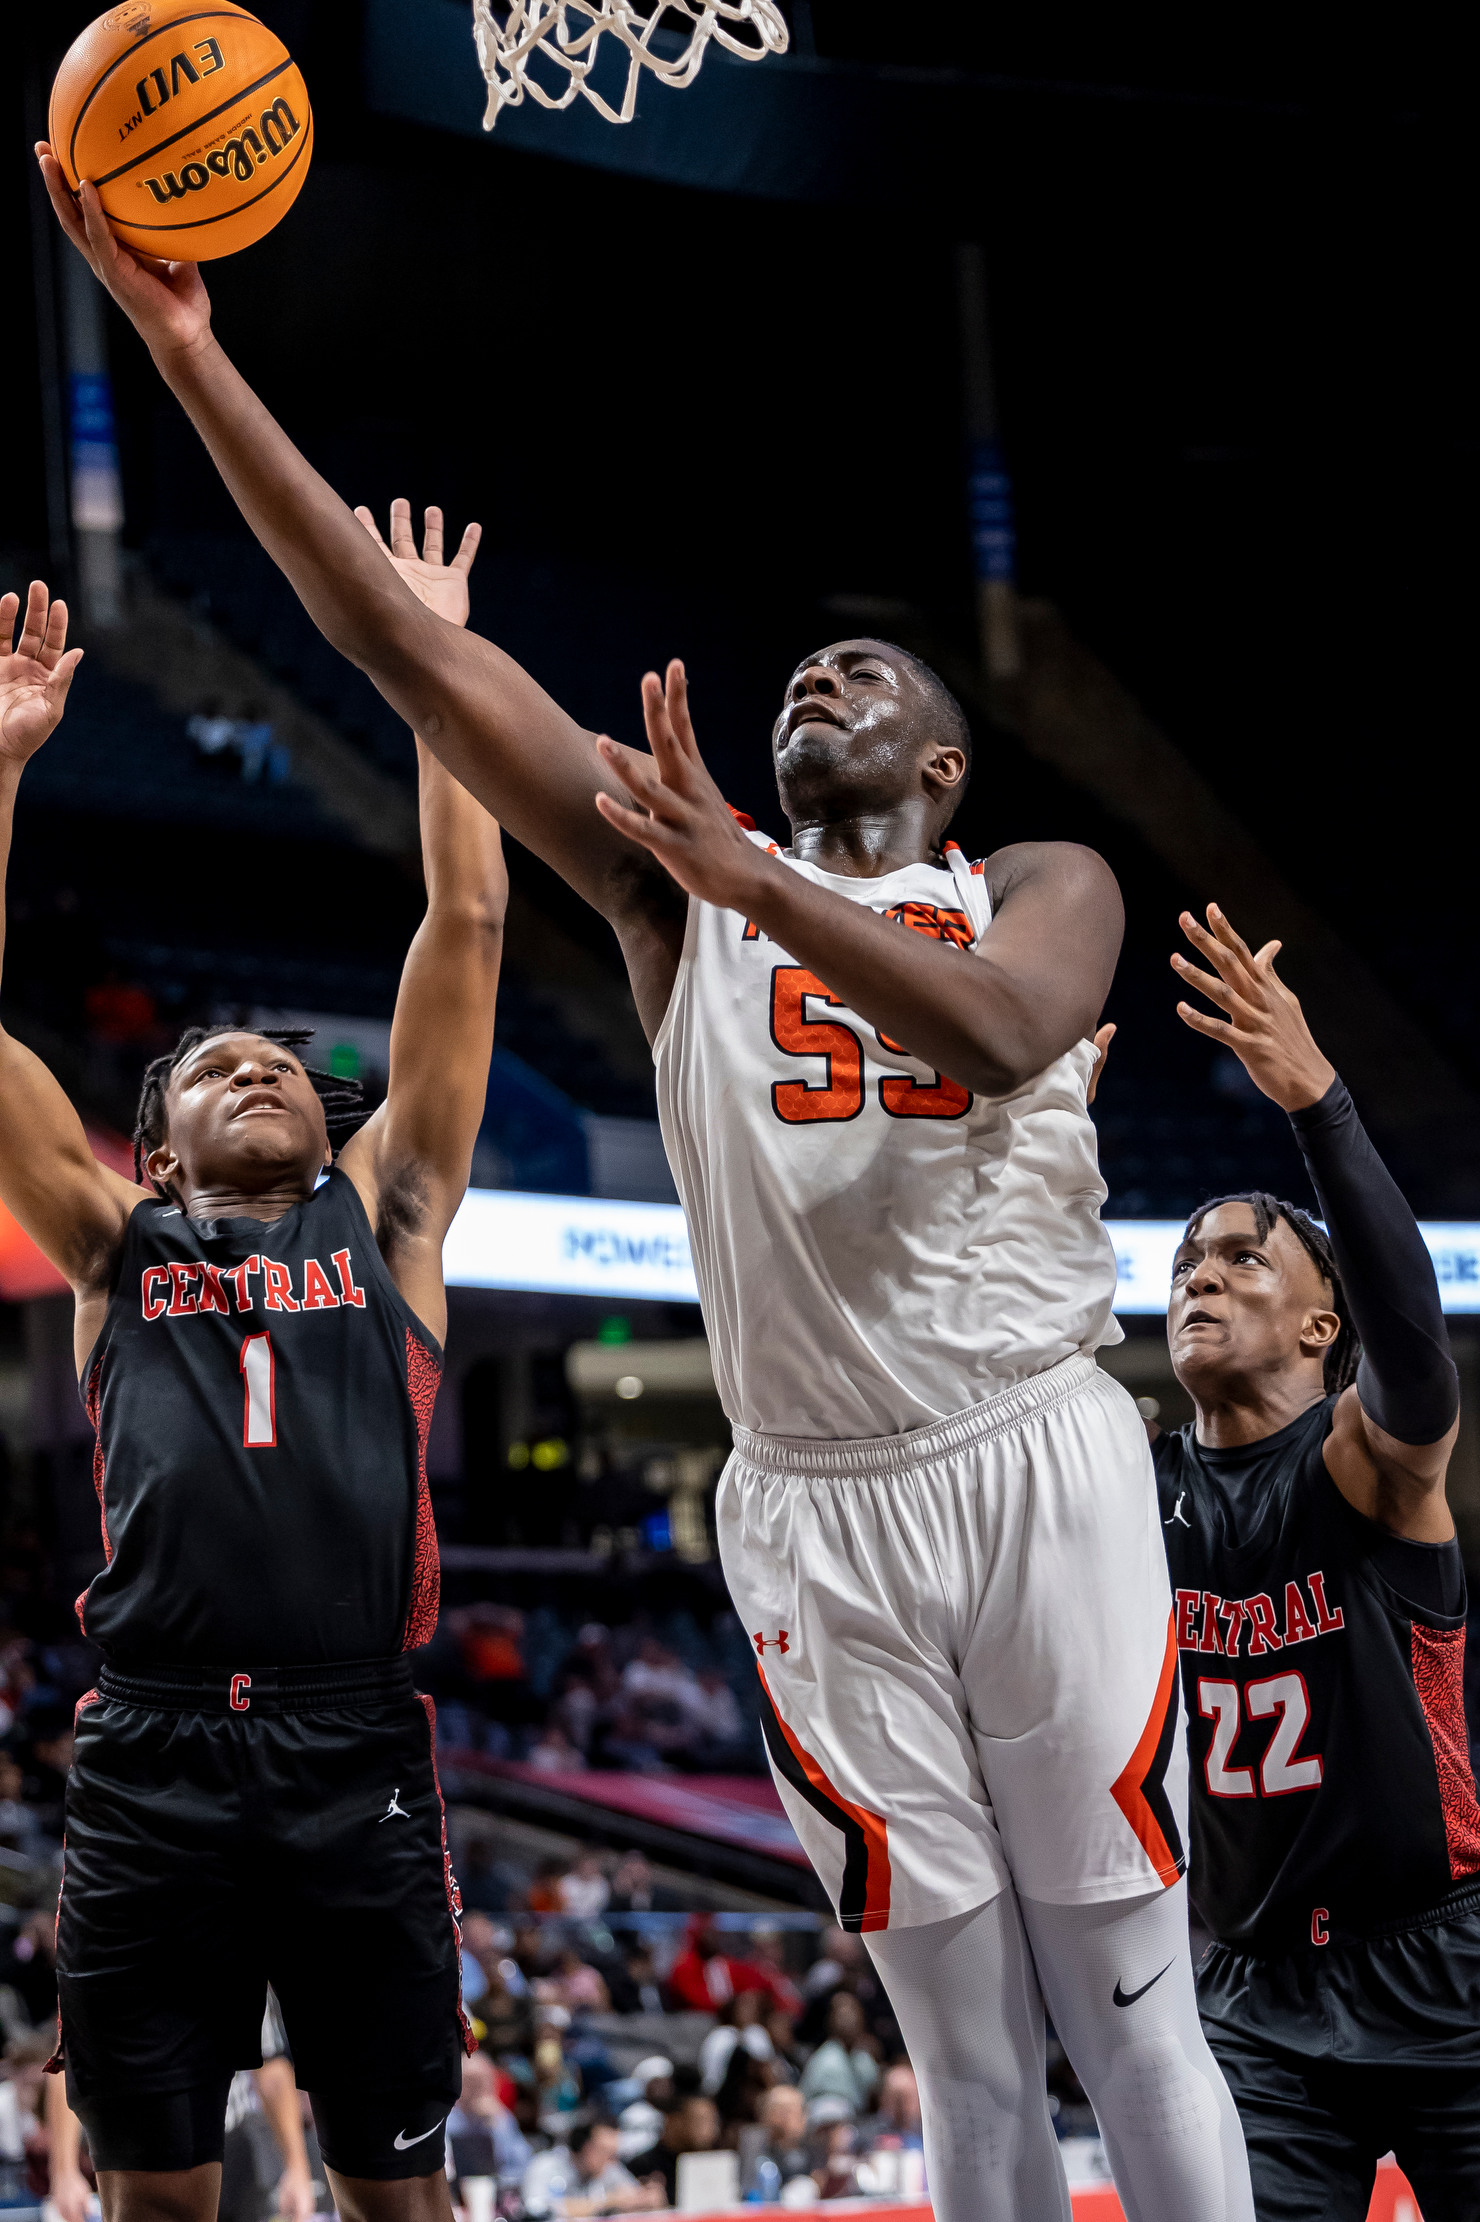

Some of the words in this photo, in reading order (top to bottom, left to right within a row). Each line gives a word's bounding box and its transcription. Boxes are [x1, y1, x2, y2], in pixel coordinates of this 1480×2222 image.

[136, 36, 225, 117] EVO
[118, 111, 143, 143] NXT
[204, 134, 226, 149] GAME
[226, 113, 252, 135] INDOOR
[143, 96, 301, 204] Wilson
[181, 148, 202, 160] BALL
[141, 1248, 366, 1321] CENTRAL
[239, 1330, 277, 1448] 1
[229, 1673, 251, 1711] C
[1197, 1669, 1324, 1798] 22
[1310, 1907, 1329, 1945] C
